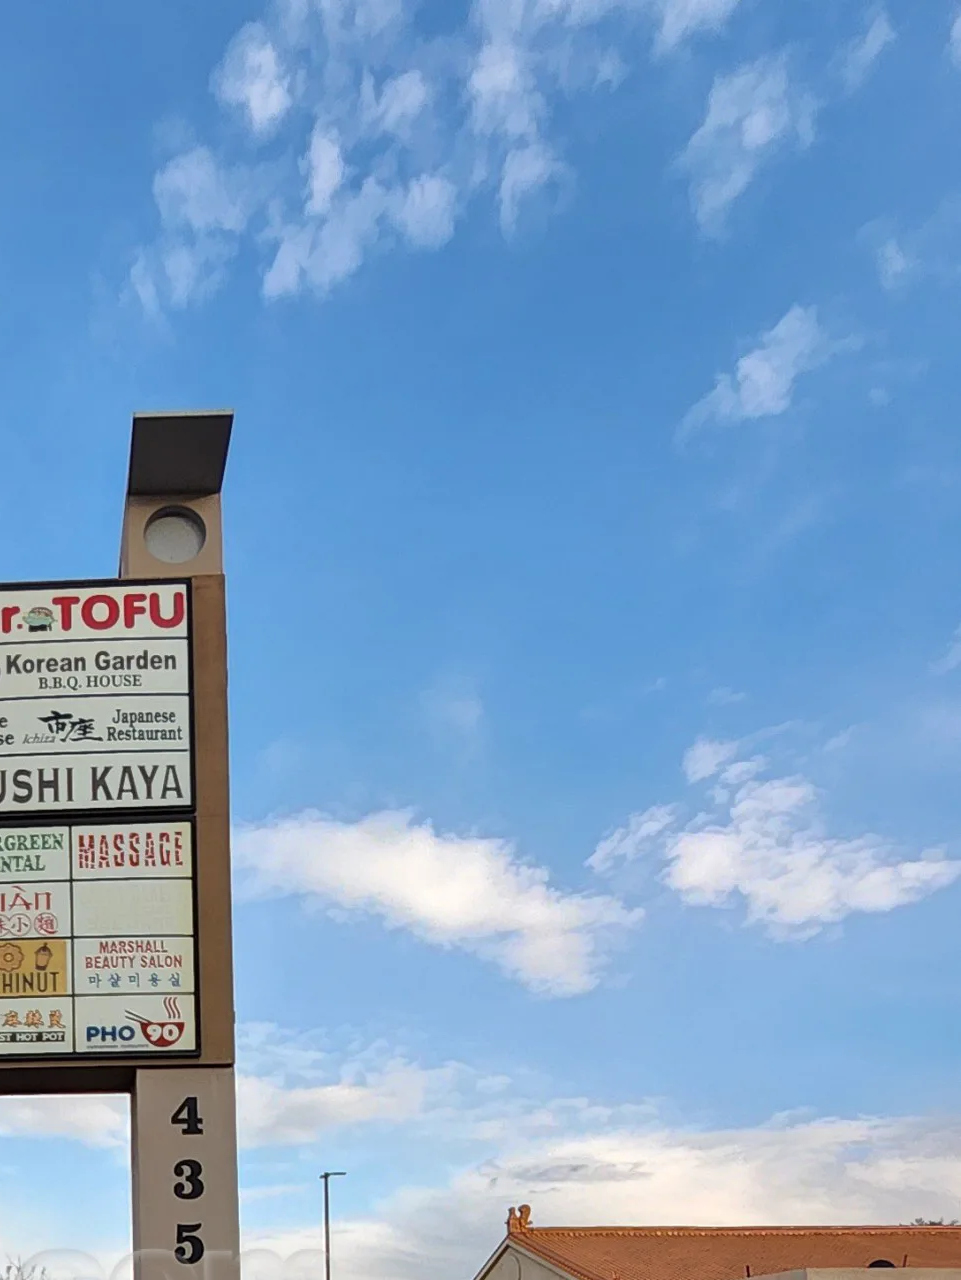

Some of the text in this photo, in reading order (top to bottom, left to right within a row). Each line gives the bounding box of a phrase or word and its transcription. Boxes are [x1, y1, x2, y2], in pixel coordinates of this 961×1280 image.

[51, 591, 185, 631] TOFU
[5, 650, 177, 675] Korean Garden
[38, 674, 142, 690] B.B.Q. HOUSE
[112, 709, 176, 727] Japanese
[106, 725, 184, 742] Restaurant
[90, 764, 184, 801] KAYA
[77, 831, 183, 869] MASSAGE
[99, 940, 168, 954] MARSHALL
[85, 954, 183, 969] BEAUTY SALON
[15, 1033, 39, 1042] HOT
[42, 1032, 64, 1041] POT
[86, 1024, 180, 1042] PHO 90
